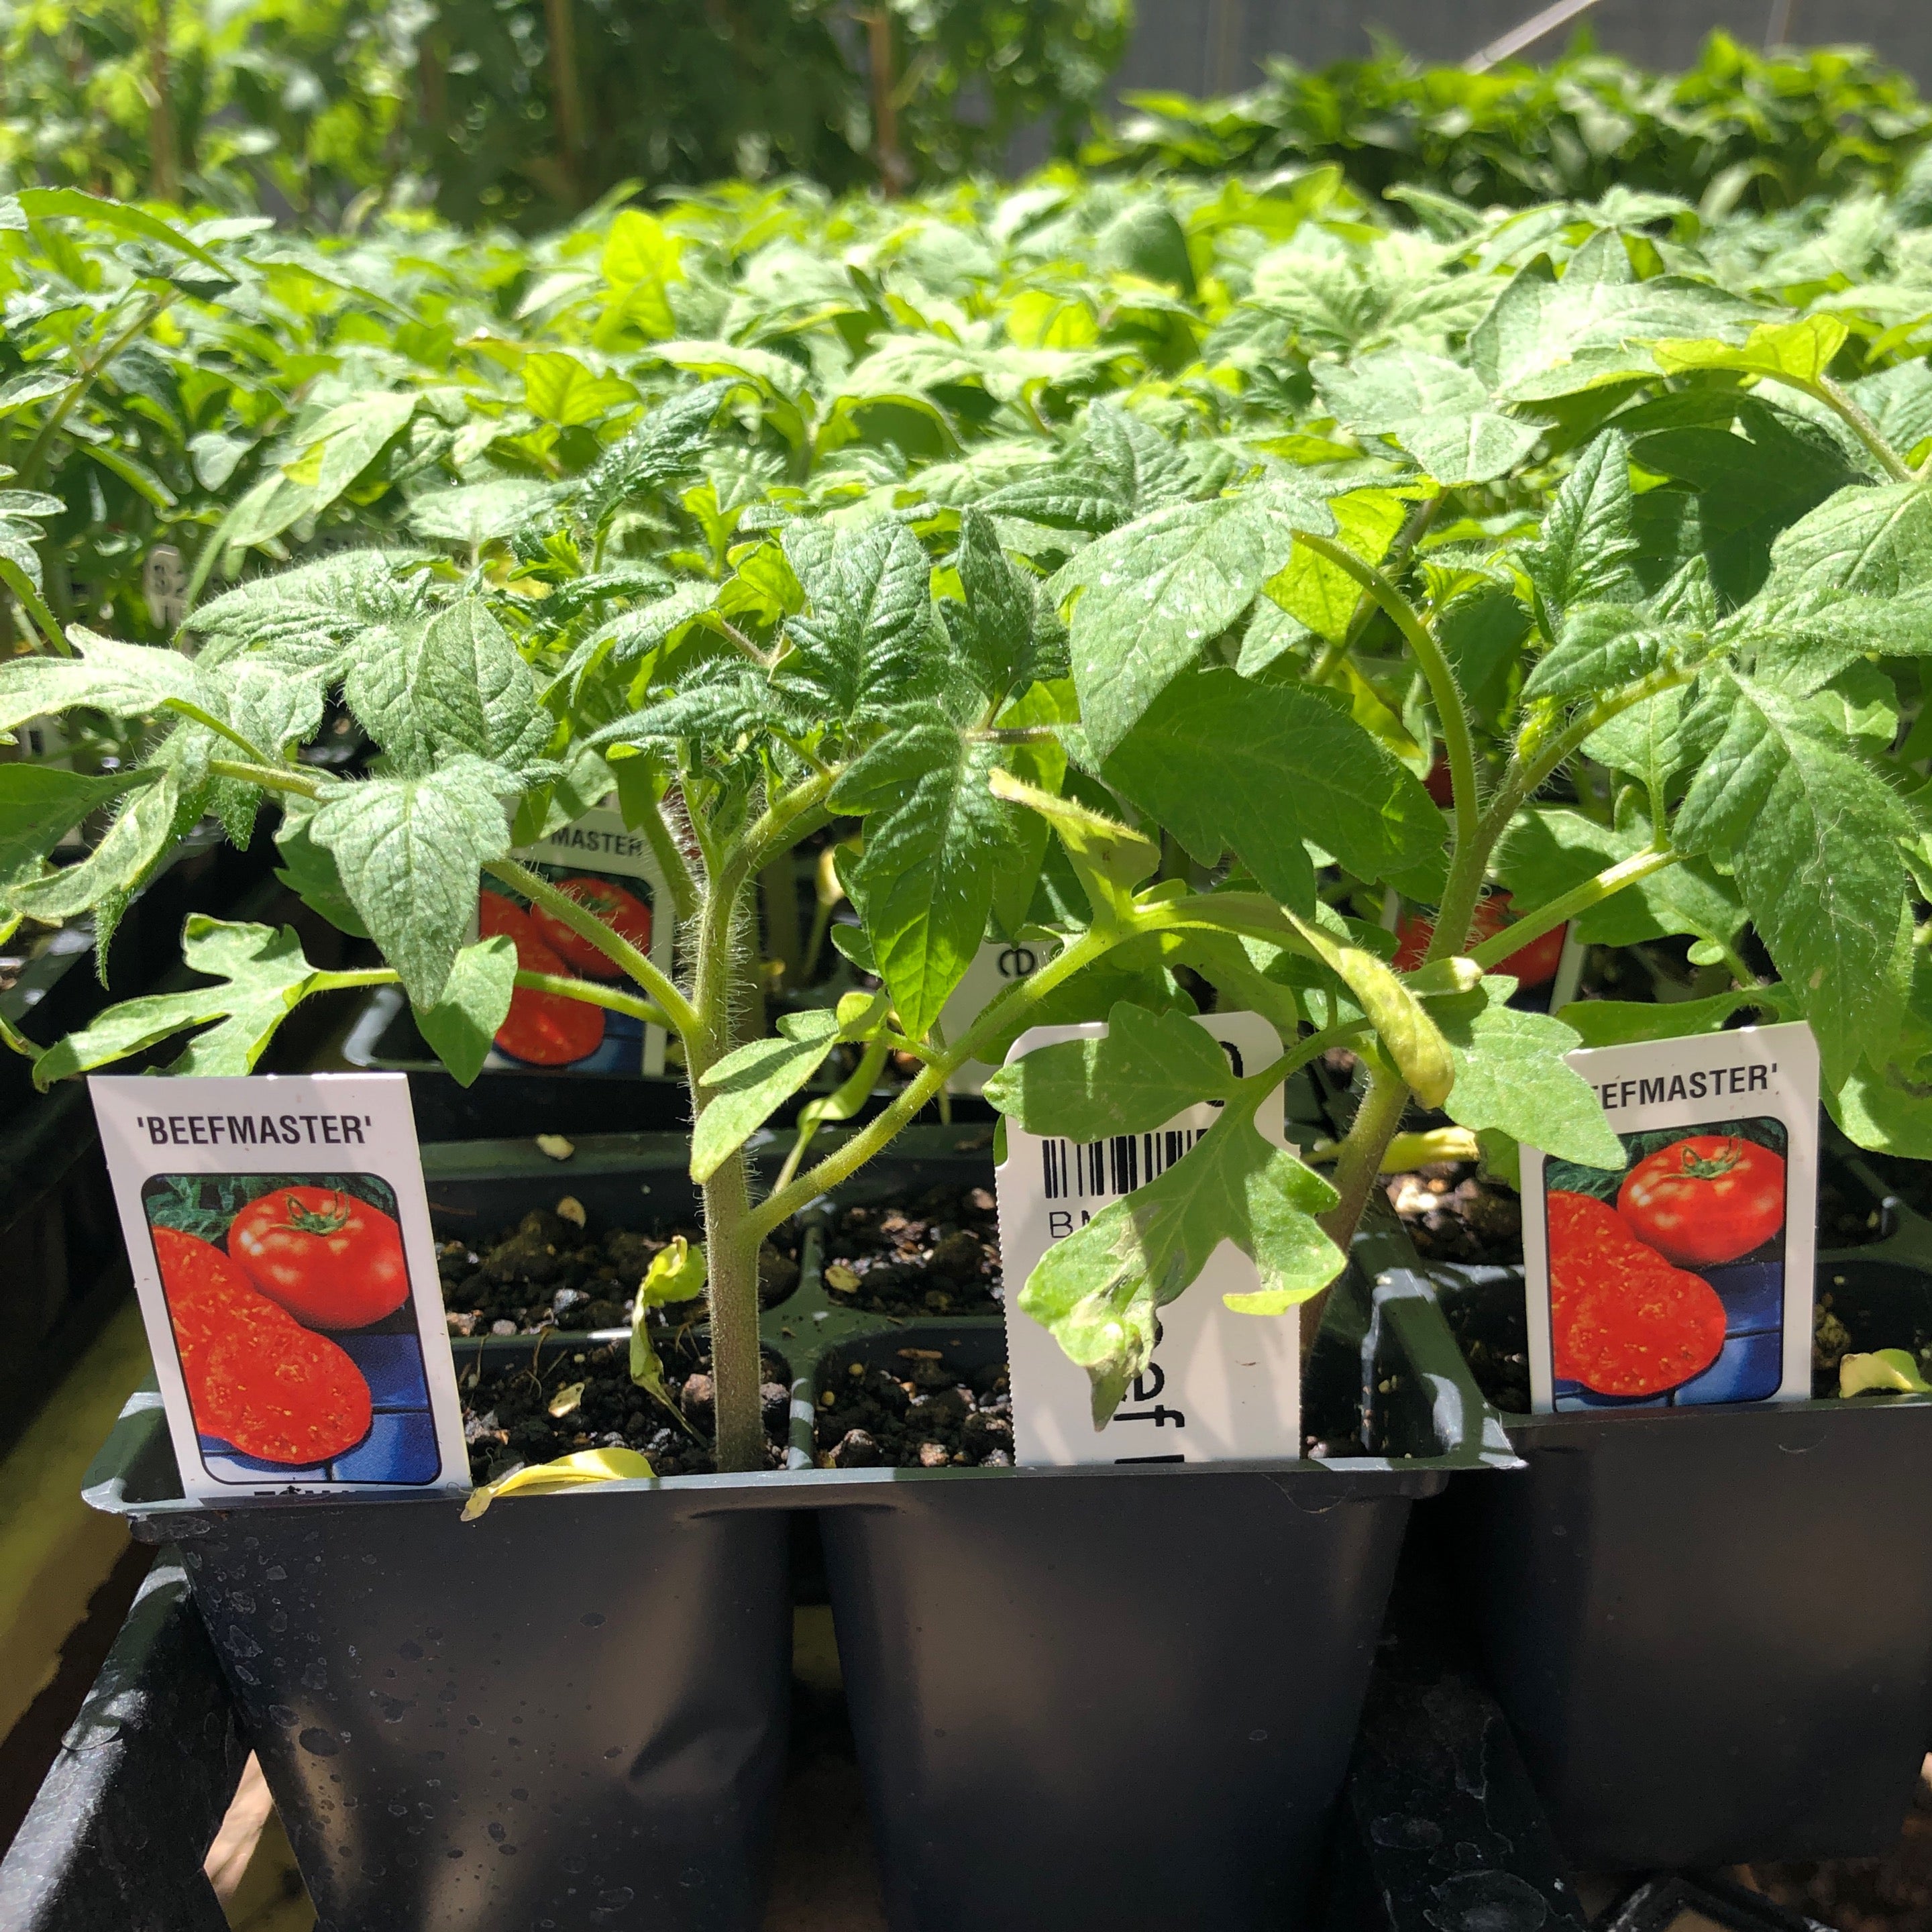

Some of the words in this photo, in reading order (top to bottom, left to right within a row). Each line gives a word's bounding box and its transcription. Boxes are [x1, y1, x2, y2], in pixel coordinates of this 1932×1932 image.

[550, 828, 643, 857] MASTER
[1593, 1063, 1778, 1110] EFMASTER'
[137, 1115, 372, 1145] 'BEEFMASTER'
